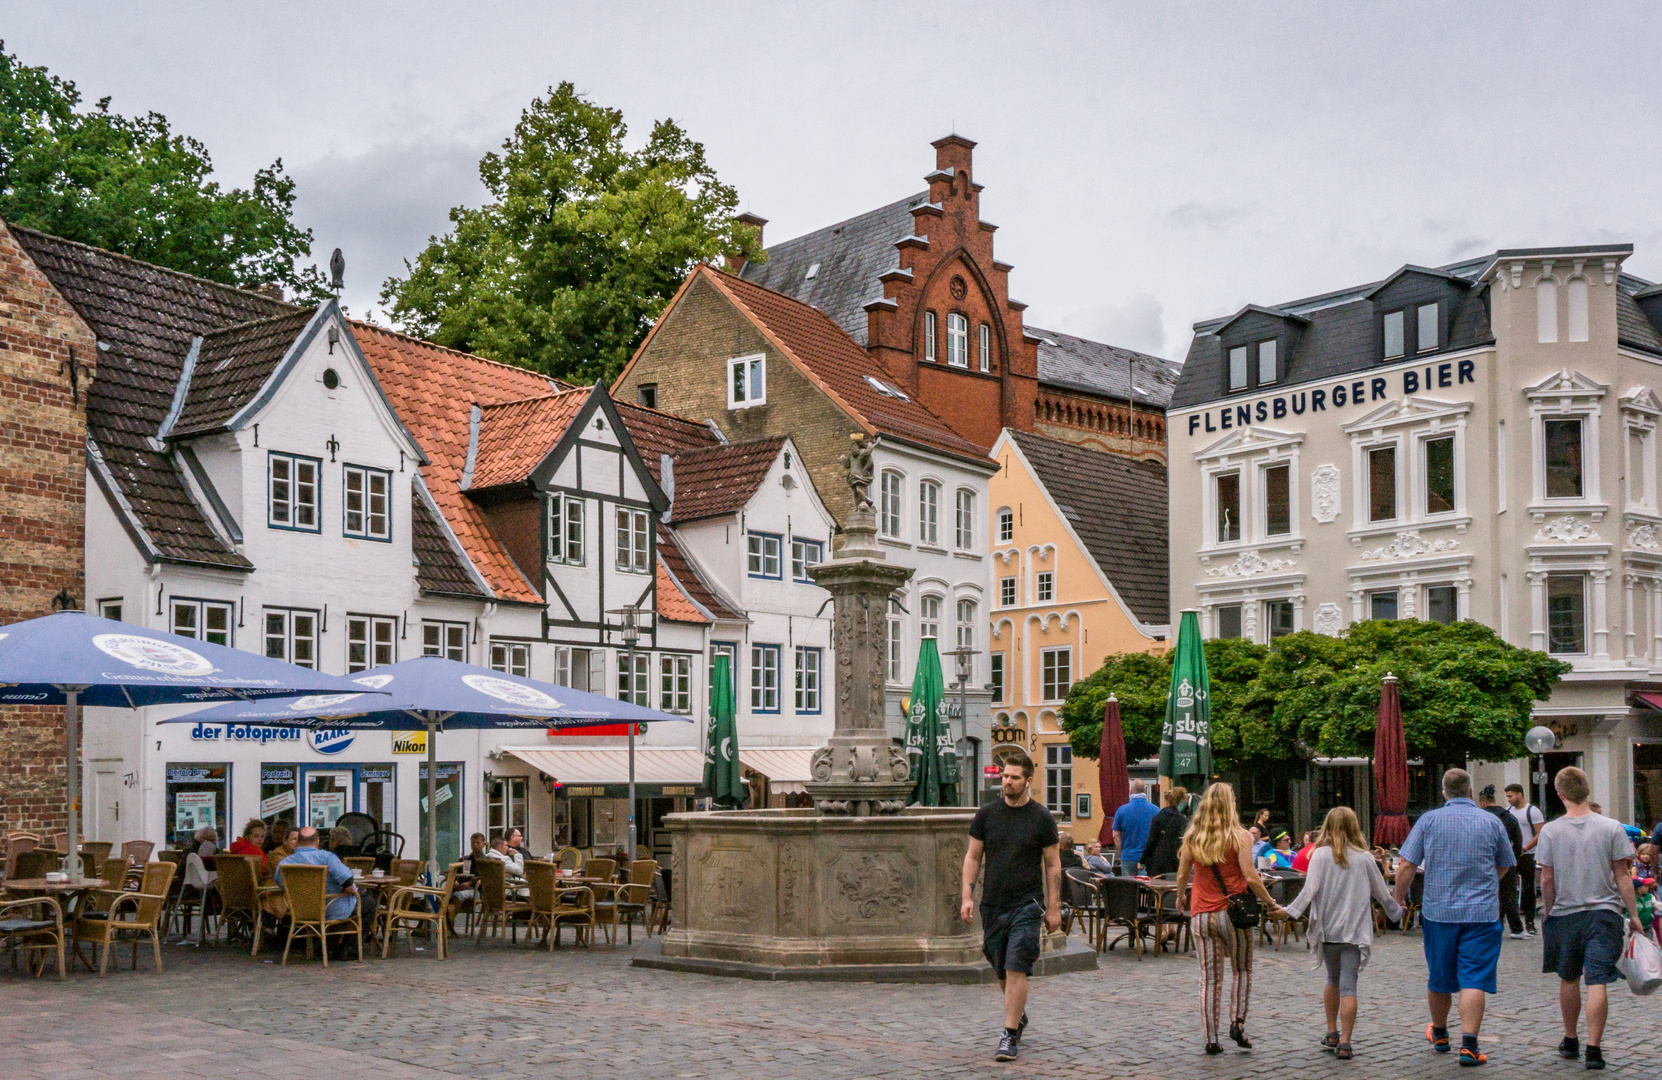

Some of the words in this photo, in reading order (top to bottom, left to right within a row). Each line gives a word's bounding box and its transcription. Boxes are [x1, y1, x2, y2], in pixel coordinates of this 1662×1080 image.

[1189, 378, 1386, 436] FLENSBURGER
[1403, 359, 1475, 394] BIER
[192, 722, 221, 739] der
[226, 724, 300, 743] Fotoprofi
[156, 741, 162, 751] 7
[393, 741, 426, 752] Nikon
